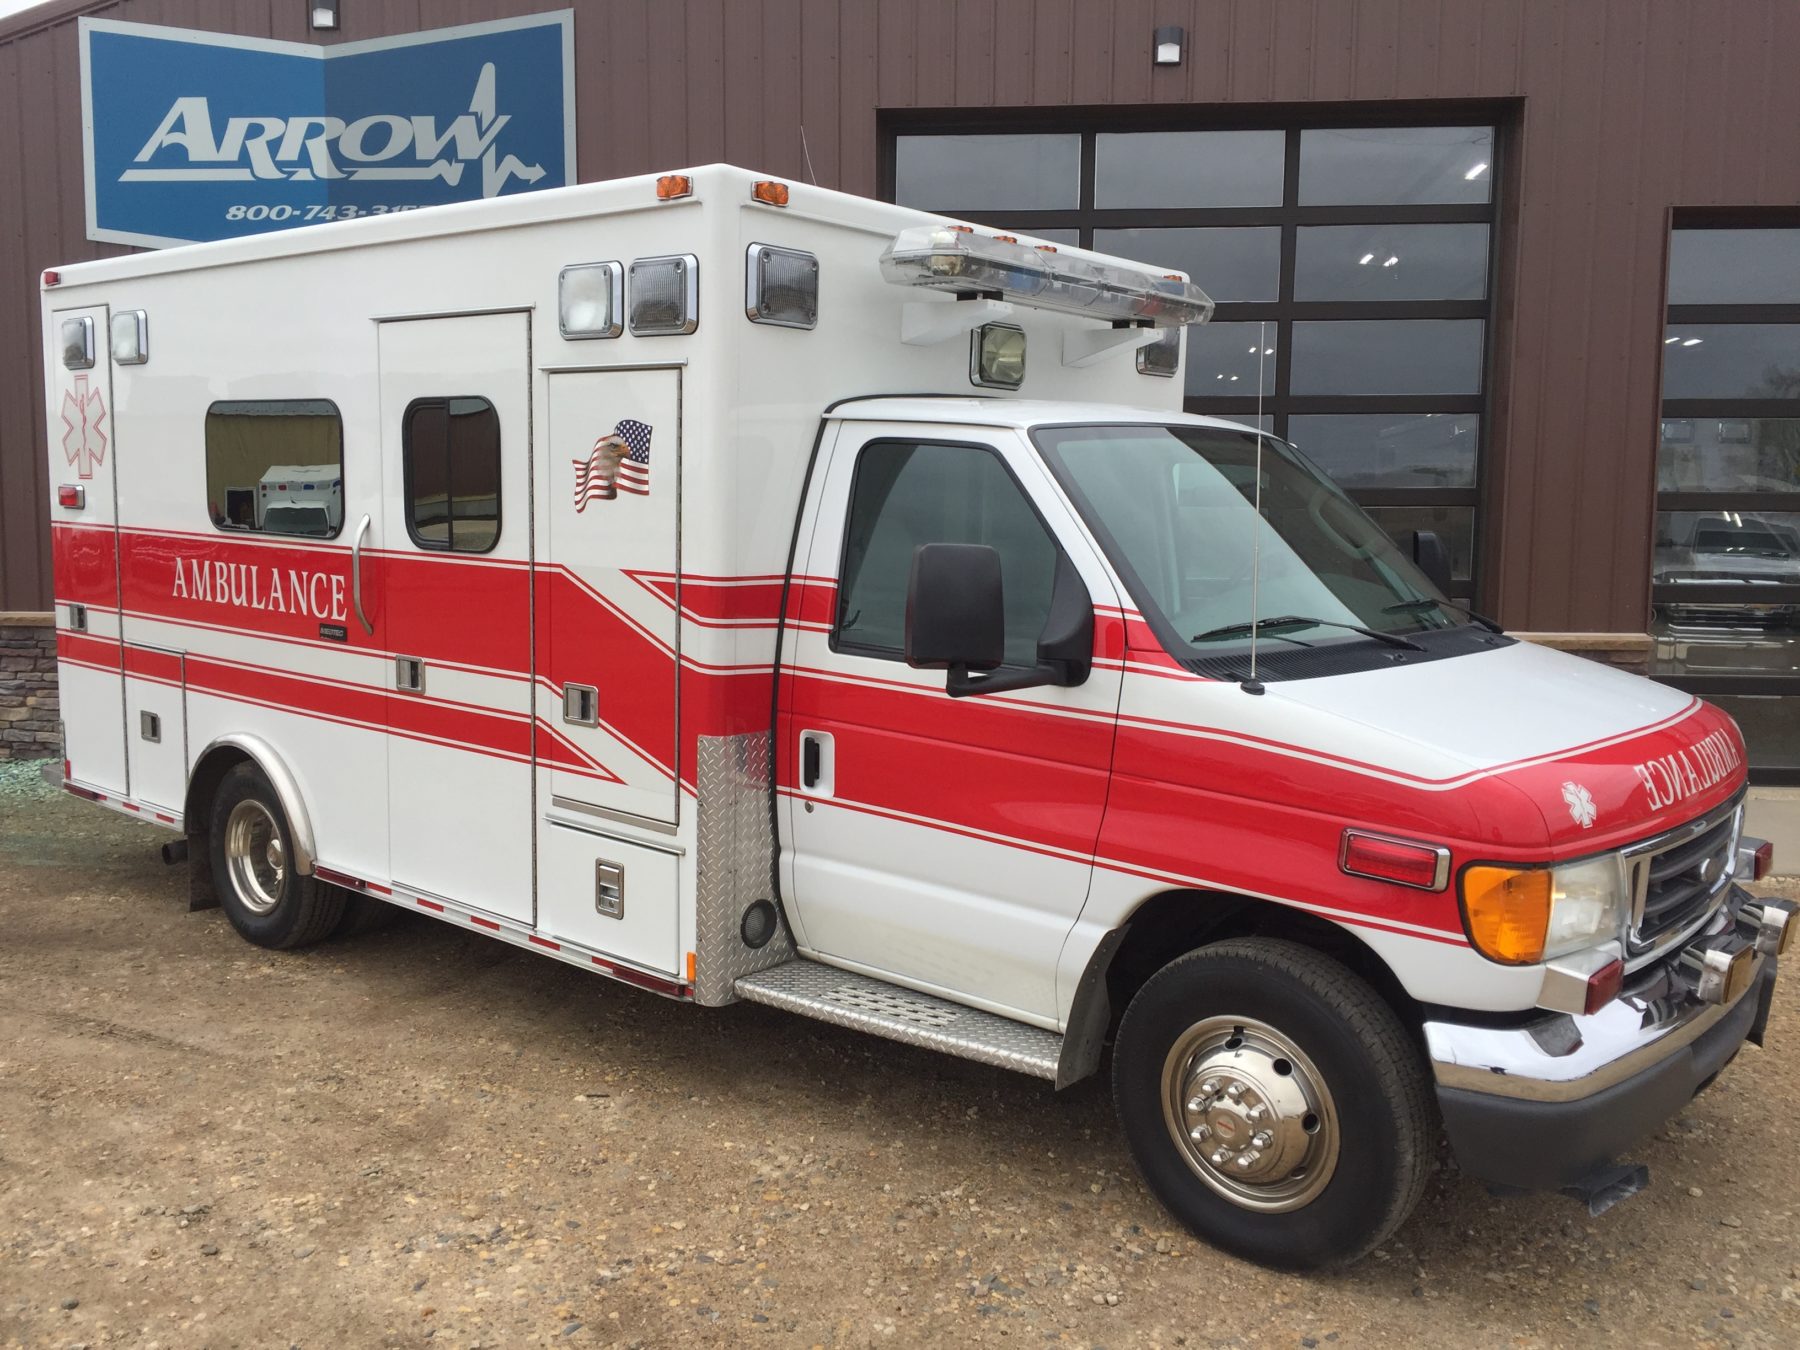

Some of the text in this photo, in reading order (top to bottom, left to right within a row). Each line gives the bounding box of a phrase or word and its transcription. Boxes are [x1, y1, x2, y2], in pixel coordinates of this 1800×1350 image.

[131, 95, 512, 182] ARROW
[226, 204, 434, 221] 800-743-31
[172, 557, 347, 621] AMBULANCE
